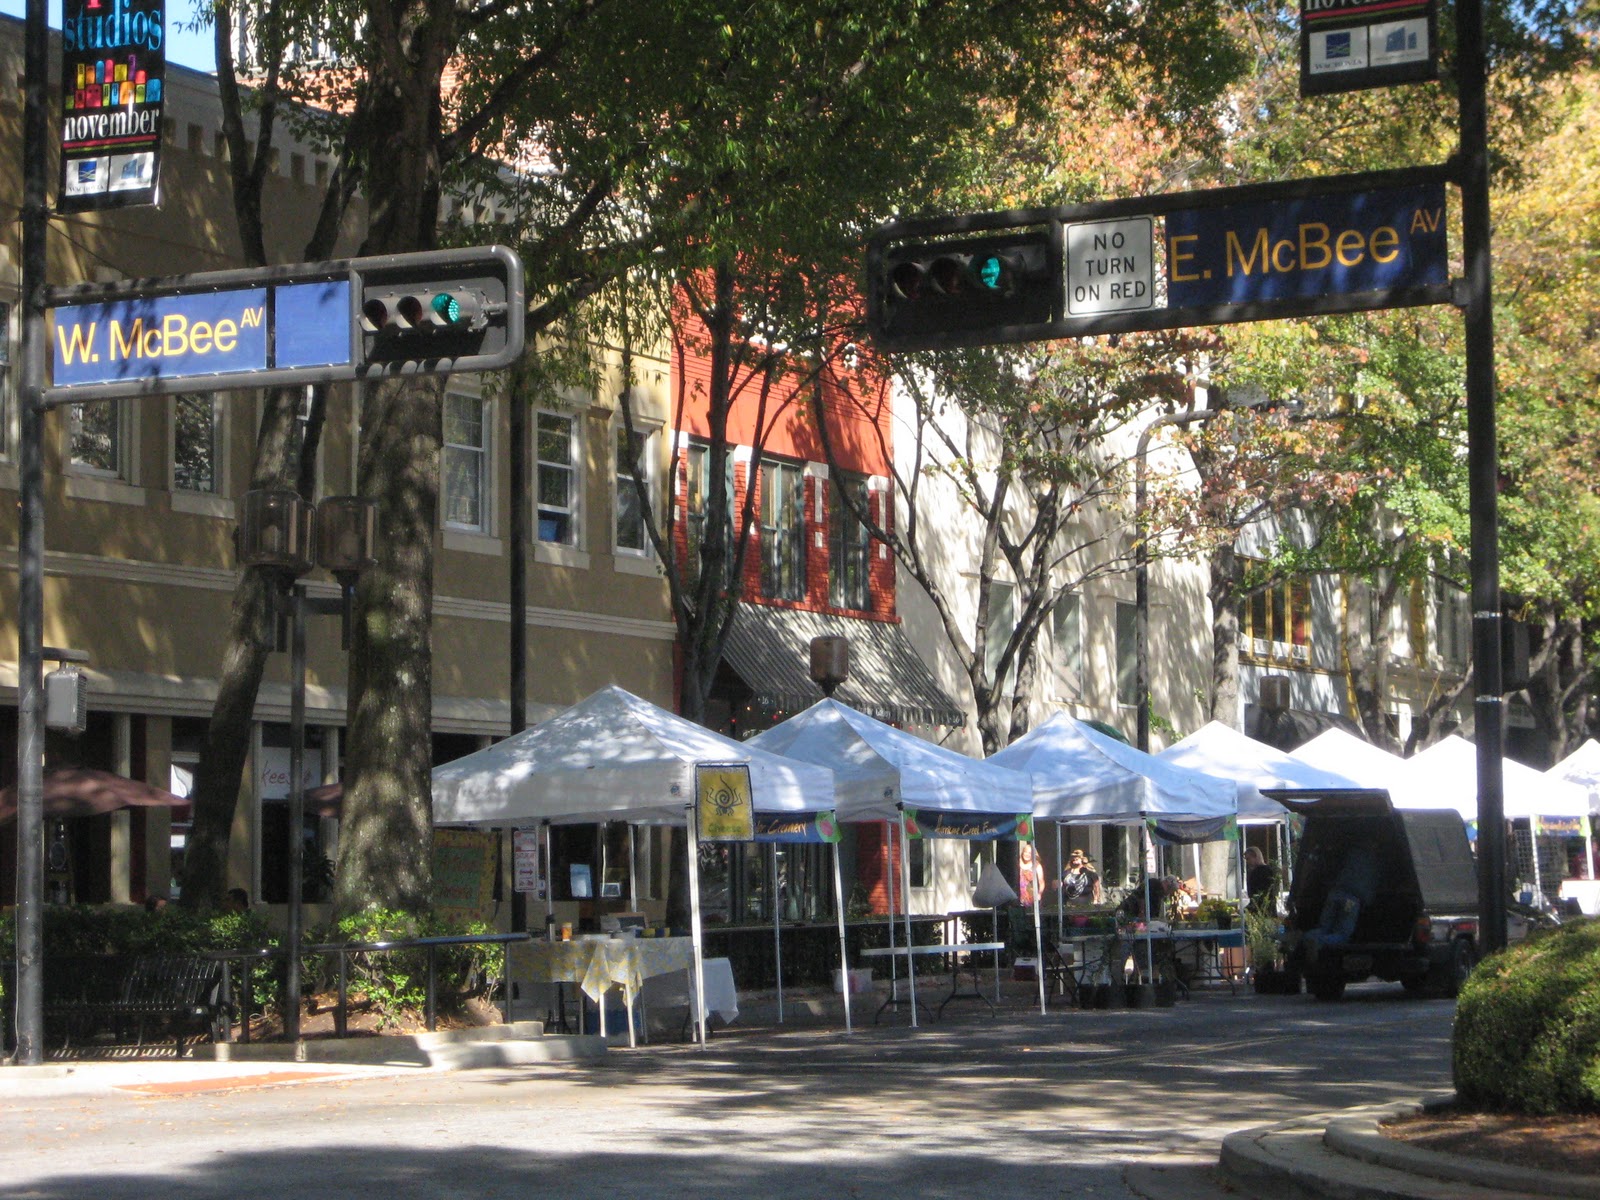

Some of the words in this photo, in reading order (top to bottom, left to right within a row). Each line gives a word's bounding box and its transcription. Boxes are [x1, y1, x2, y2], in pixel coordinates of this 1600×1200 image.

[64, 0, 162, 51] studios
[64, 92, 160, 141] november
[1093, 232, 1126, 251] NO
[1170, 234, 1212, 282] E.
[1226, 222, 1400, 277] McBee
[1410, 207, 1442, 235] AV
[1085, 256, 1136, 277] TURN
[1074, 285, 1101, 303] ON
[1110, 280, 1146, 299] RED
[57, 322, 99, 365] W.
[109, 314, 238, 361] McBee
[240, 306, 263, 328] AV
